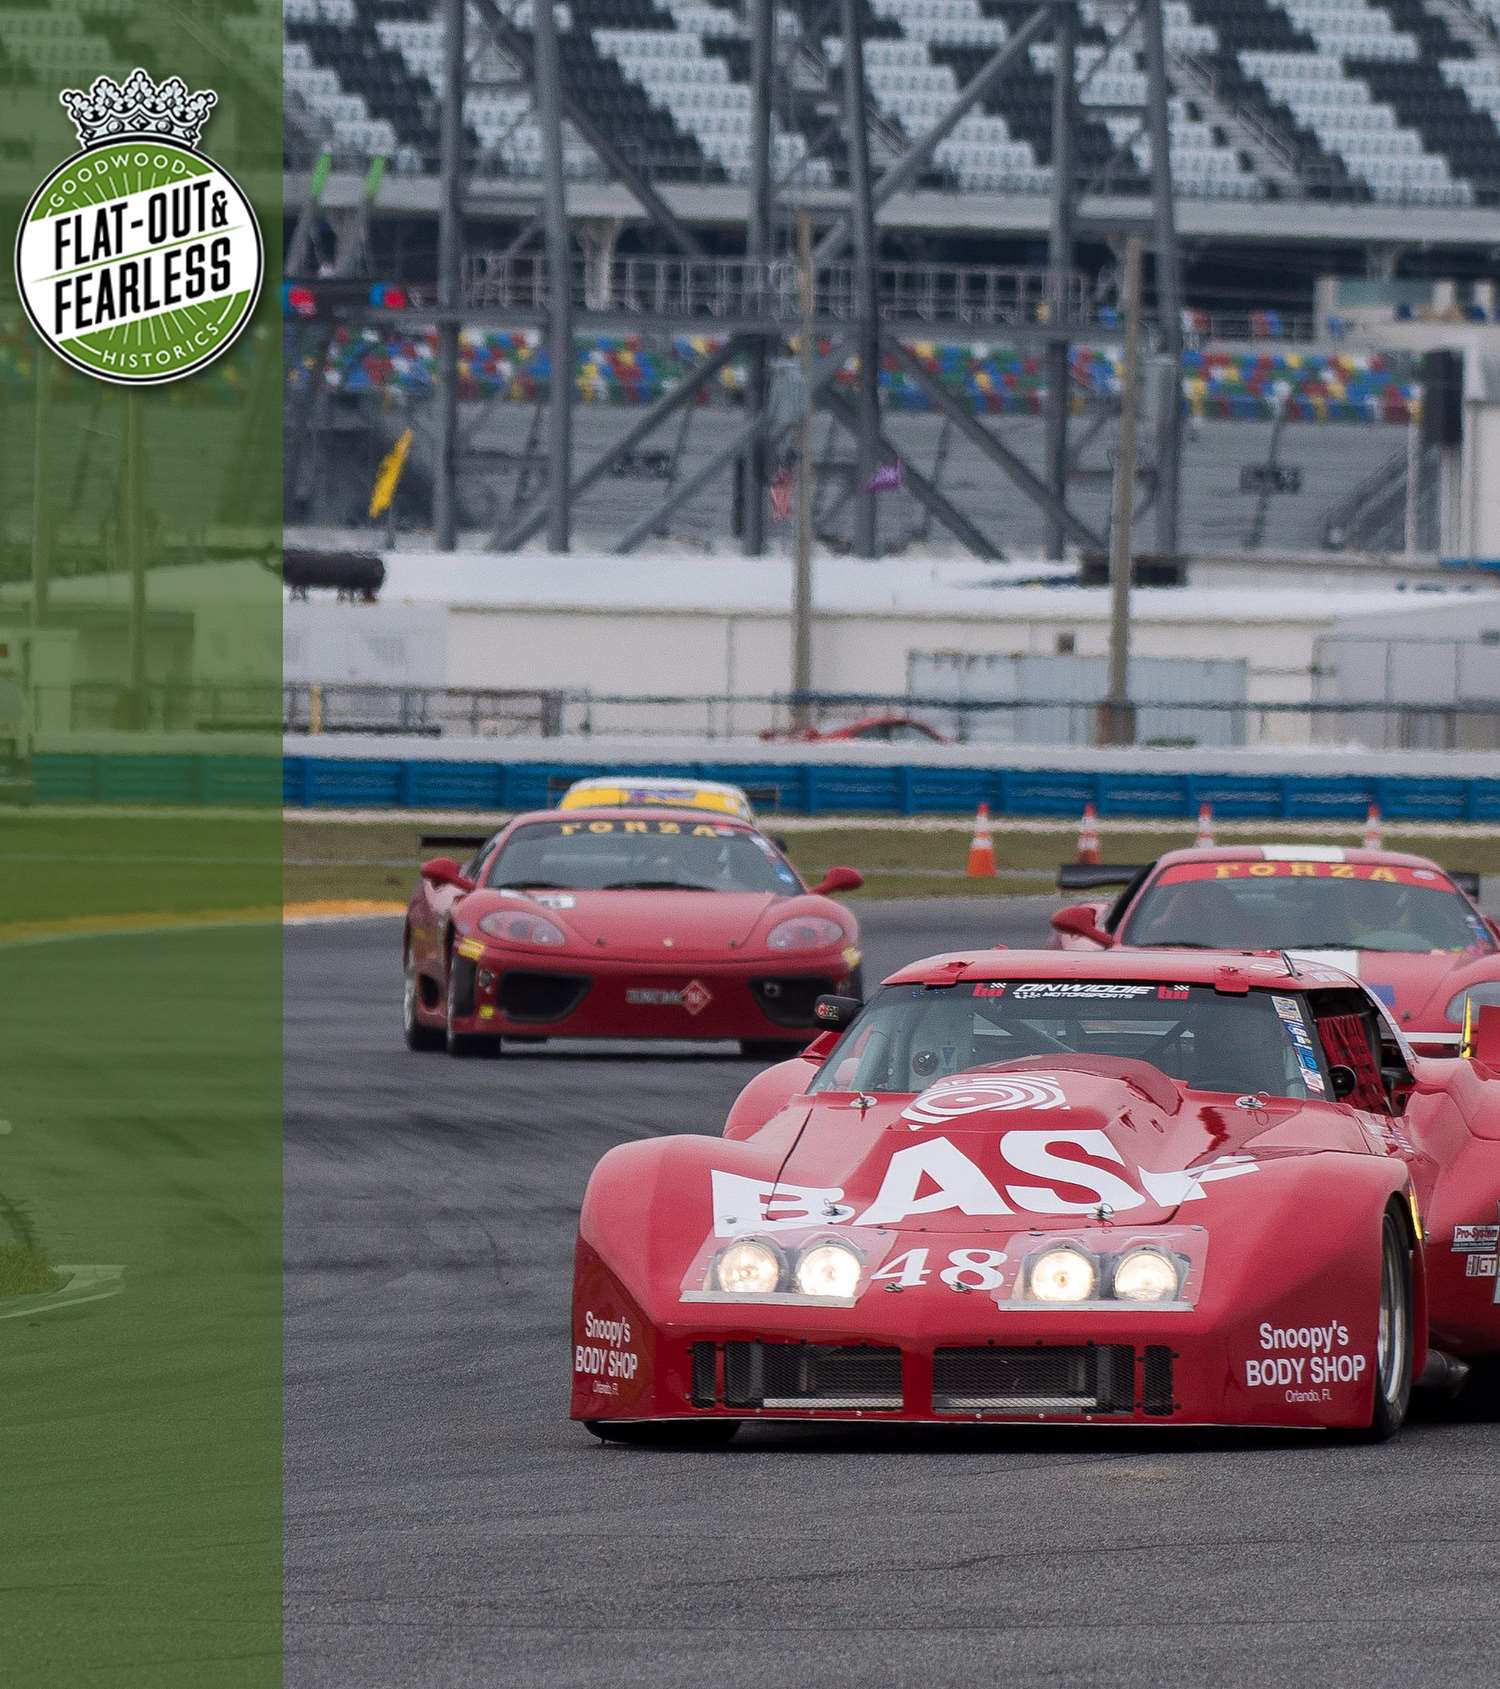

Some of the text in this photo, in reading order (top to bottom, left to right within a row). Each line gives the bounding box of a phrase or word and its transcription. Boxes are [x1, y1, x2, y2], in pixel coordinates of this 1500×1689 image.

[561, 820, 718, 838] FORZA
[1216, 861, 1398, 882] FORZA
[1015, 984, 1155, 995] DINWIDDIE
[871, 1247, 1008, 1292] 48
[585, 1311, 631, 1348] Snoopy's
[1259, 1320, 1349, 1354] Snoopy's
[575, 1345, 638, 1379] BODY SHOP
[1246, 1354, 1366, 1387] BODY SHOP
